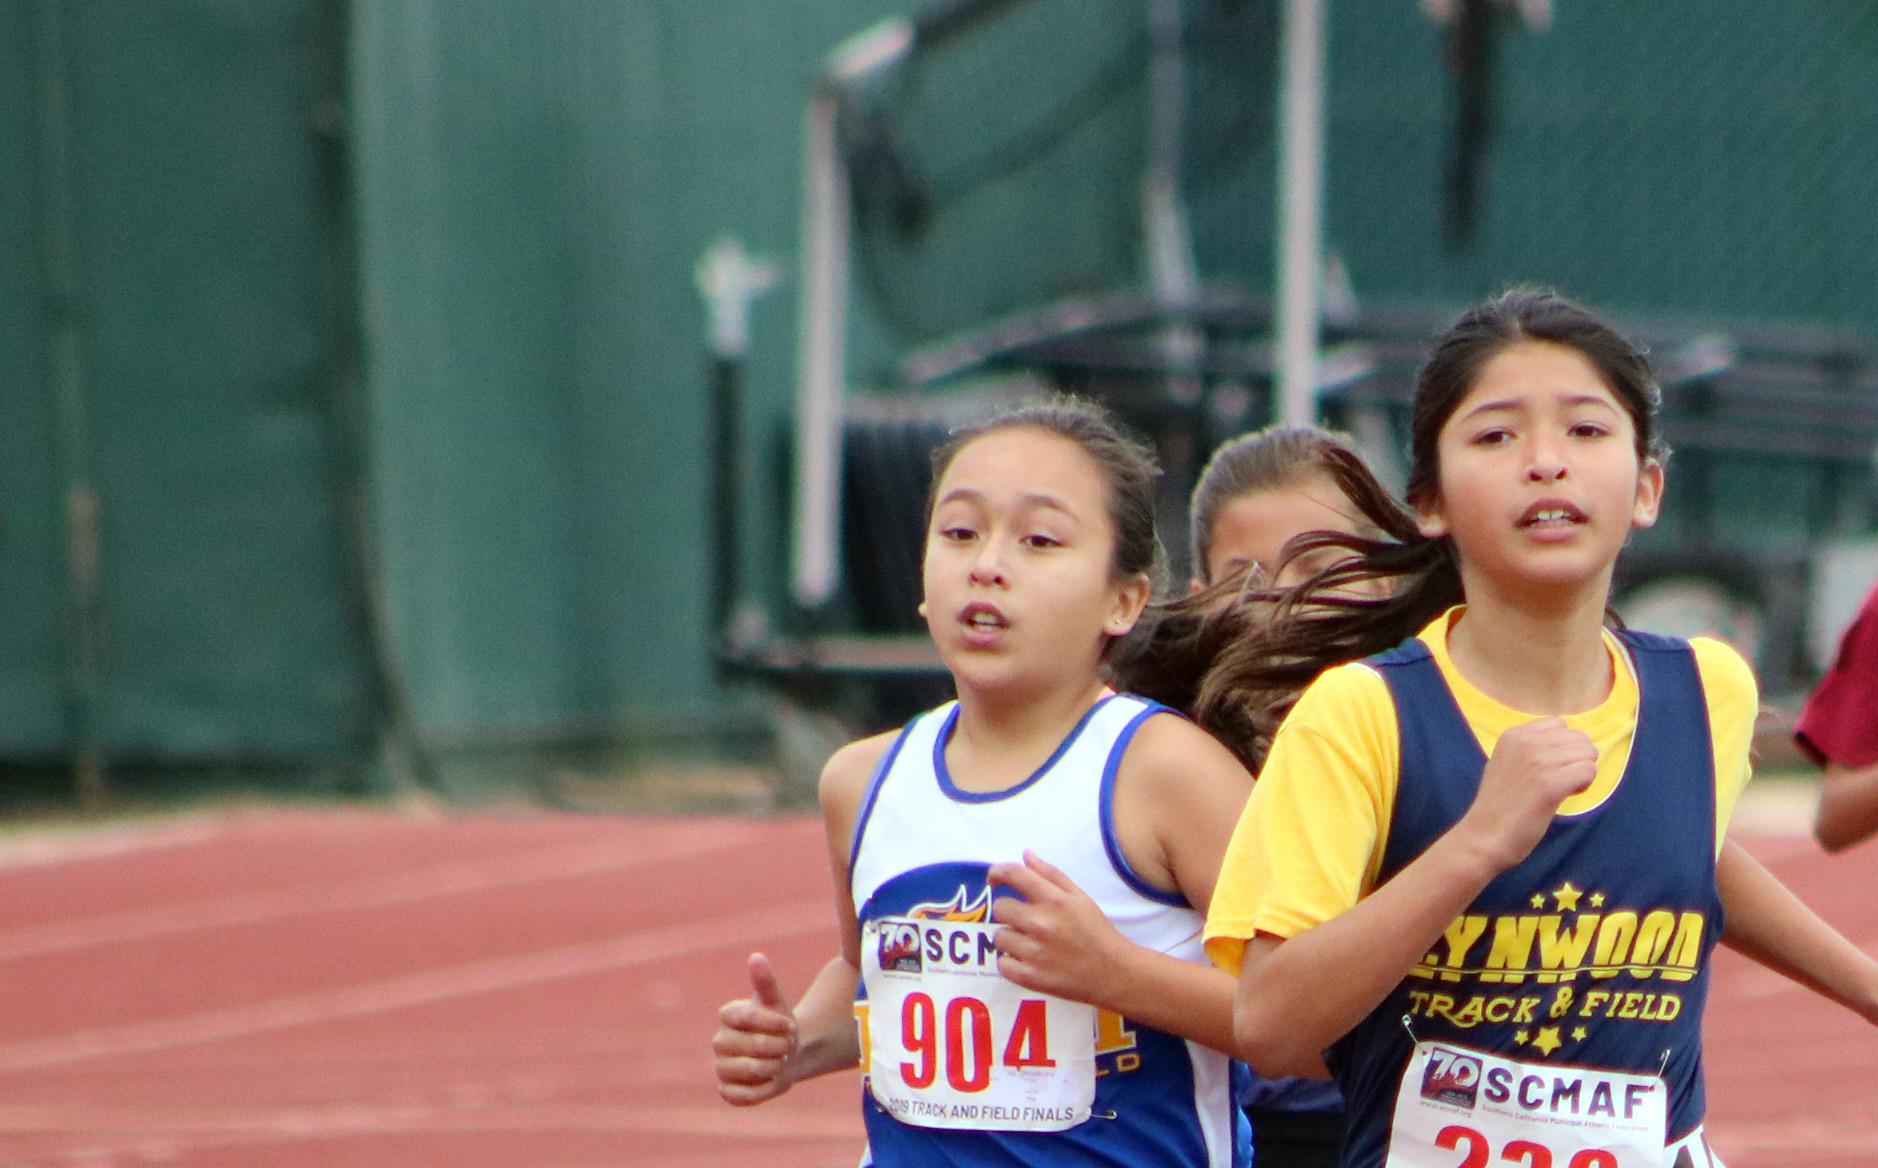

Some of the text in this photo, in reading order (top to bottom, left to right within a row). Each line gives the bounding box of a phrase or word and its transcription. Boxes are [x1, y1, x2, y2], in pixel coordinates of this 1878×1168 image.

[1409, 986, 1681, 1029] TRACK & FIELD
[900, 991, 1056, 1094] 904
[911, 1100, 948, 1117] TRACK
[951, 1104, 979, 1119] AND
[980, 1105, 1020, 1120] FIELD
[1023, 1106, 1074, 1122] FINALS
[1483, 1067, 1654, 1120] SCMAF
